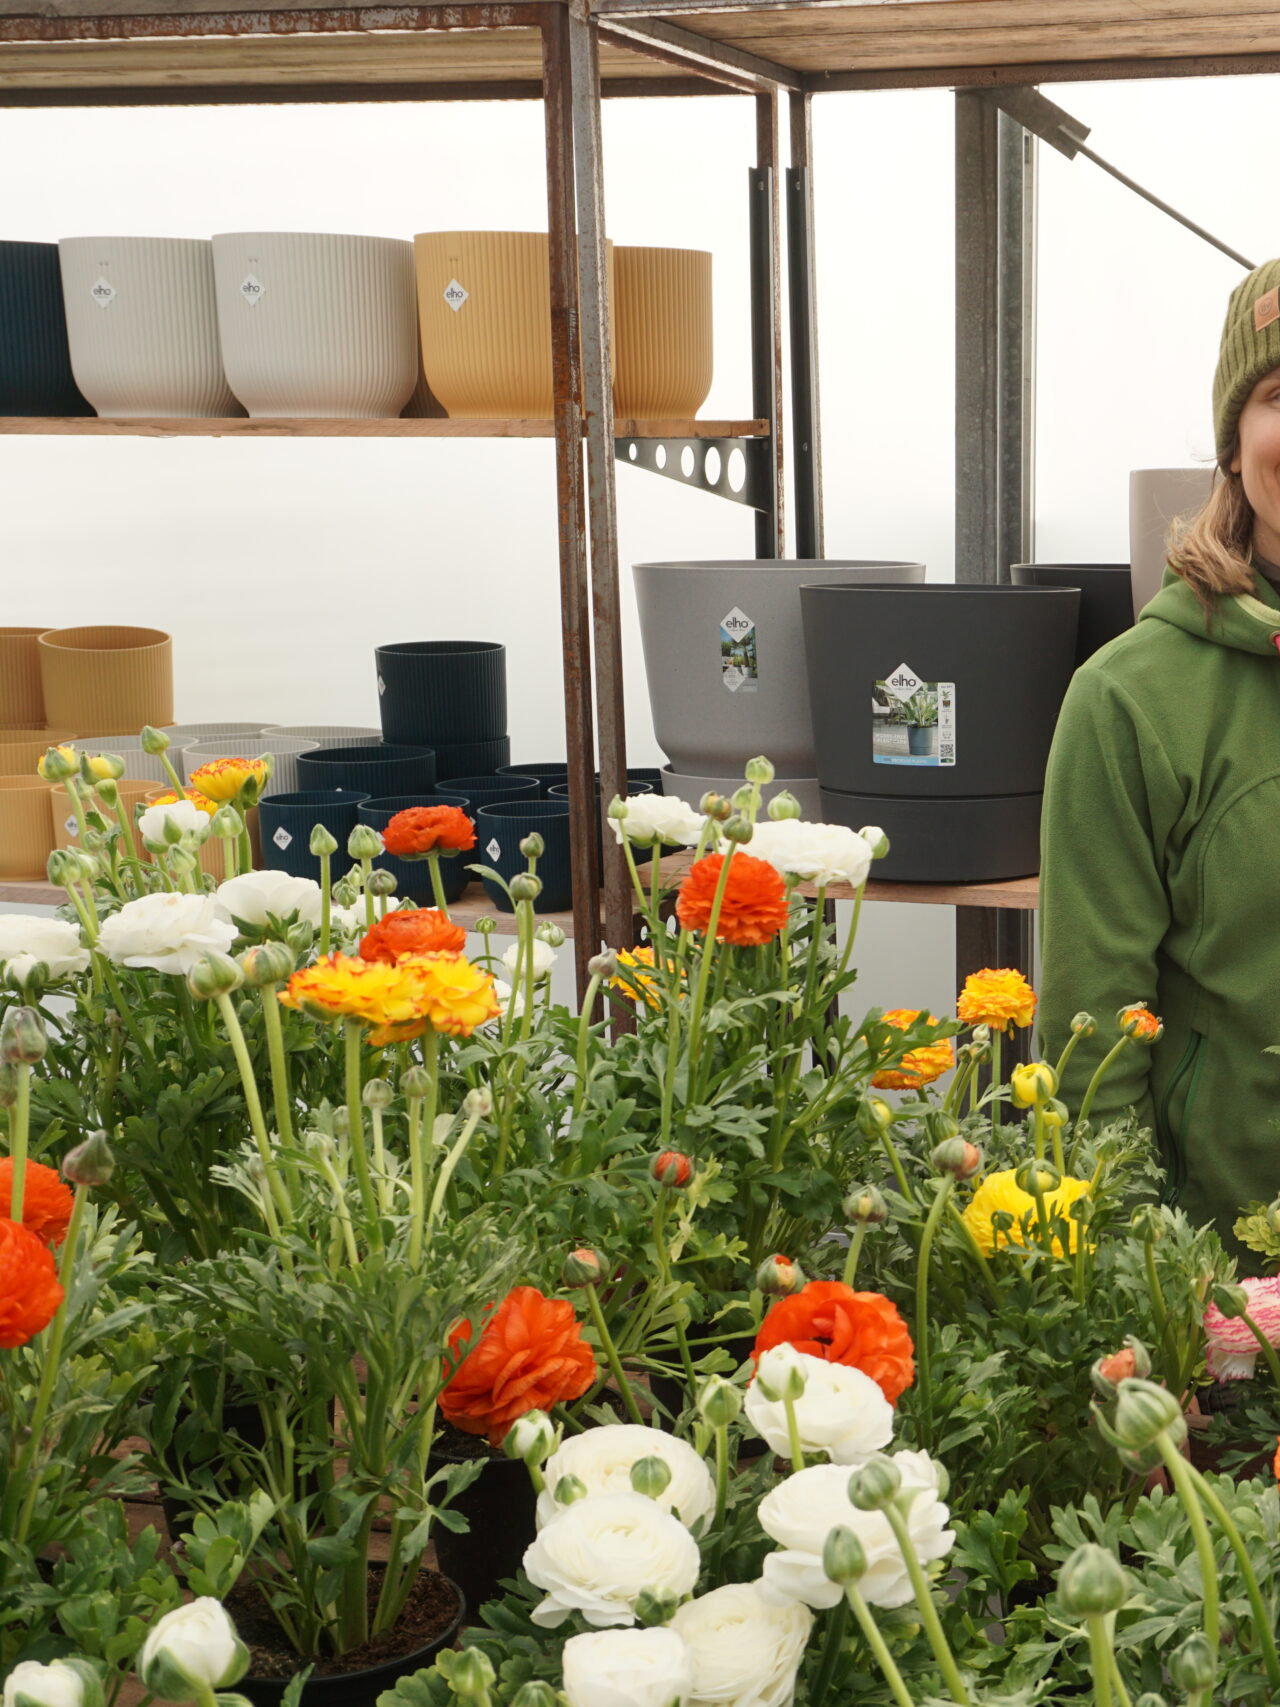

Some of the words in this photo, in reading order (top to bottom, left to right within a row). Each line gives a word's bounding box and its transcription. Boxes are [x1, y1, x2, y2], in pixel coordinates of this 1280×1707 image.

[93, 285, 111, 296] elho
[242, 281, 260, 293] elho
[446, 287, 463, 299] elho
[725, 616, 749, 629] elho
[891, 673, 917, 687] elho
